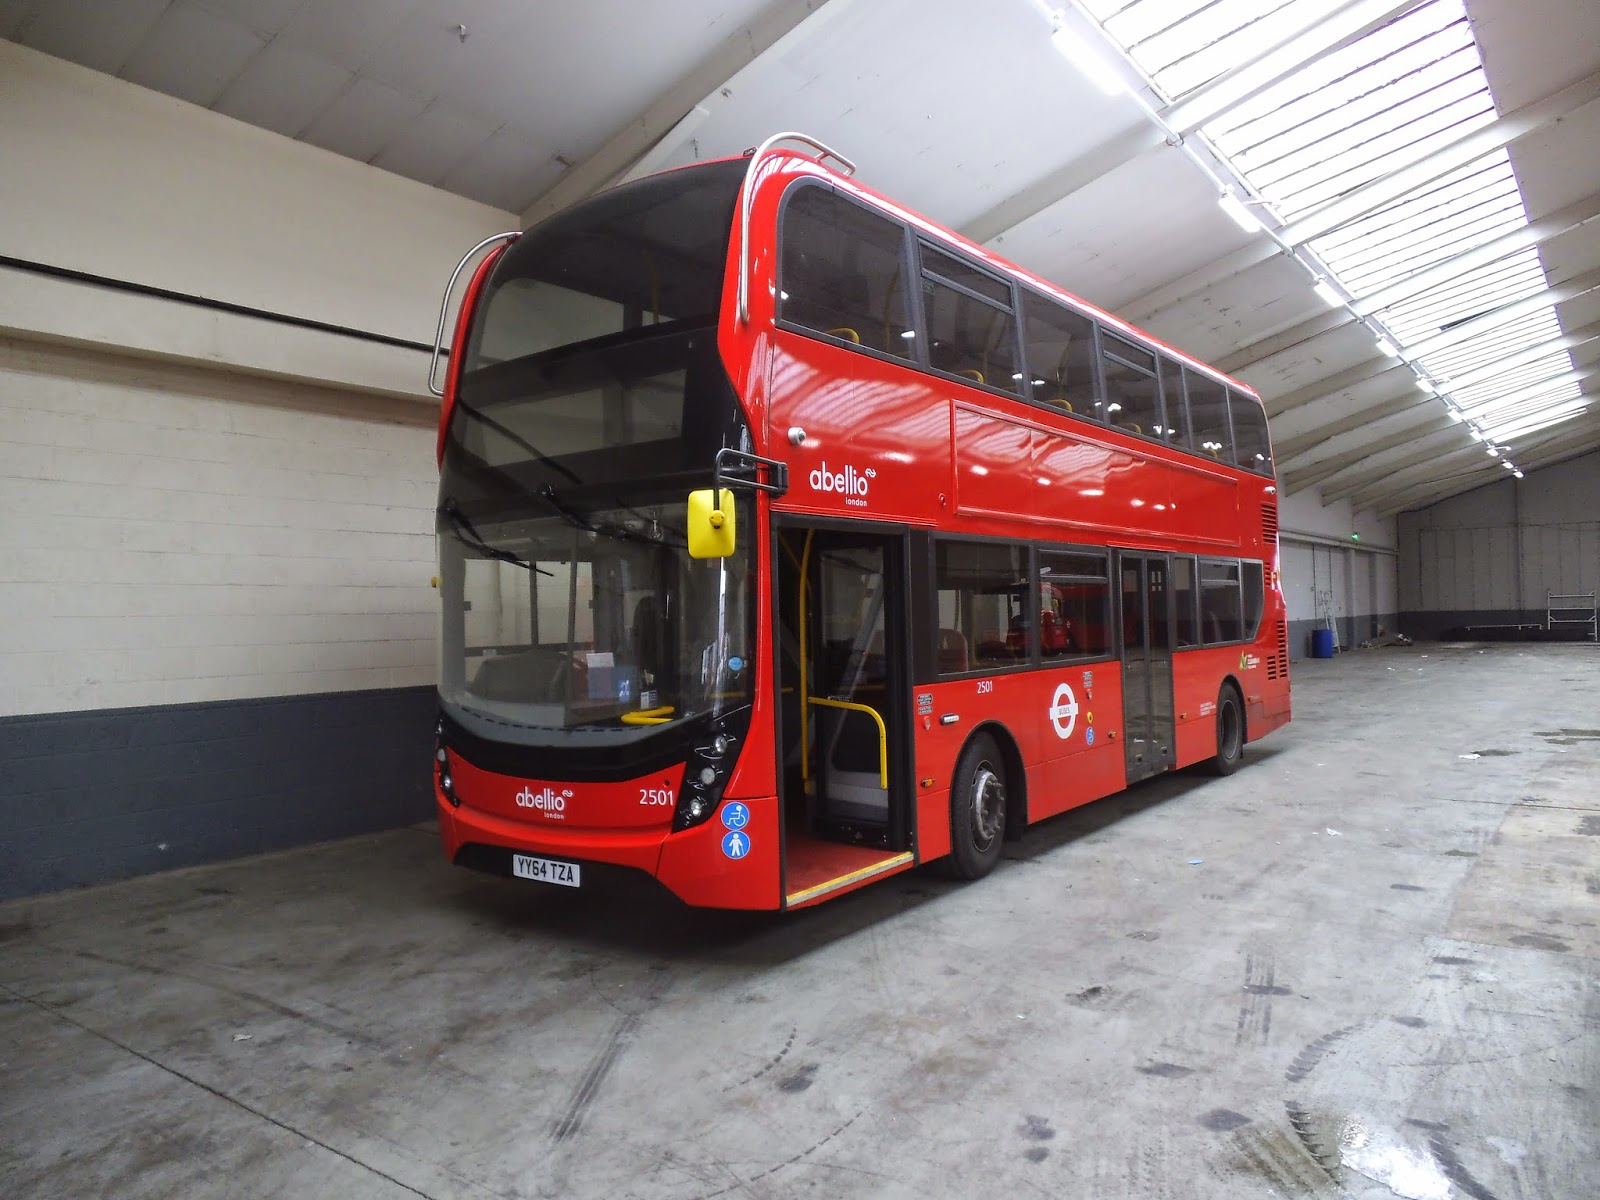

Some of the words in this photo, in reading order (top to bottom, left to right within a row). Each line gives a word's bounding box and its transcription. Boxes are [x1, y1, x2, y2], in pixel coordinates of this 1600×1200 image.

[809, 461, 868, 495] abellio
[845, 497, 867, 507] london
[977, 681, 993, 694] 2501
[515, 786, 565, 811] abellio
[639, 789, 674, 806] 2501
[544, 812, 564, 820] london
[517, 857, 547, 878] YY64
[550, 863, 574, 883] TZA
